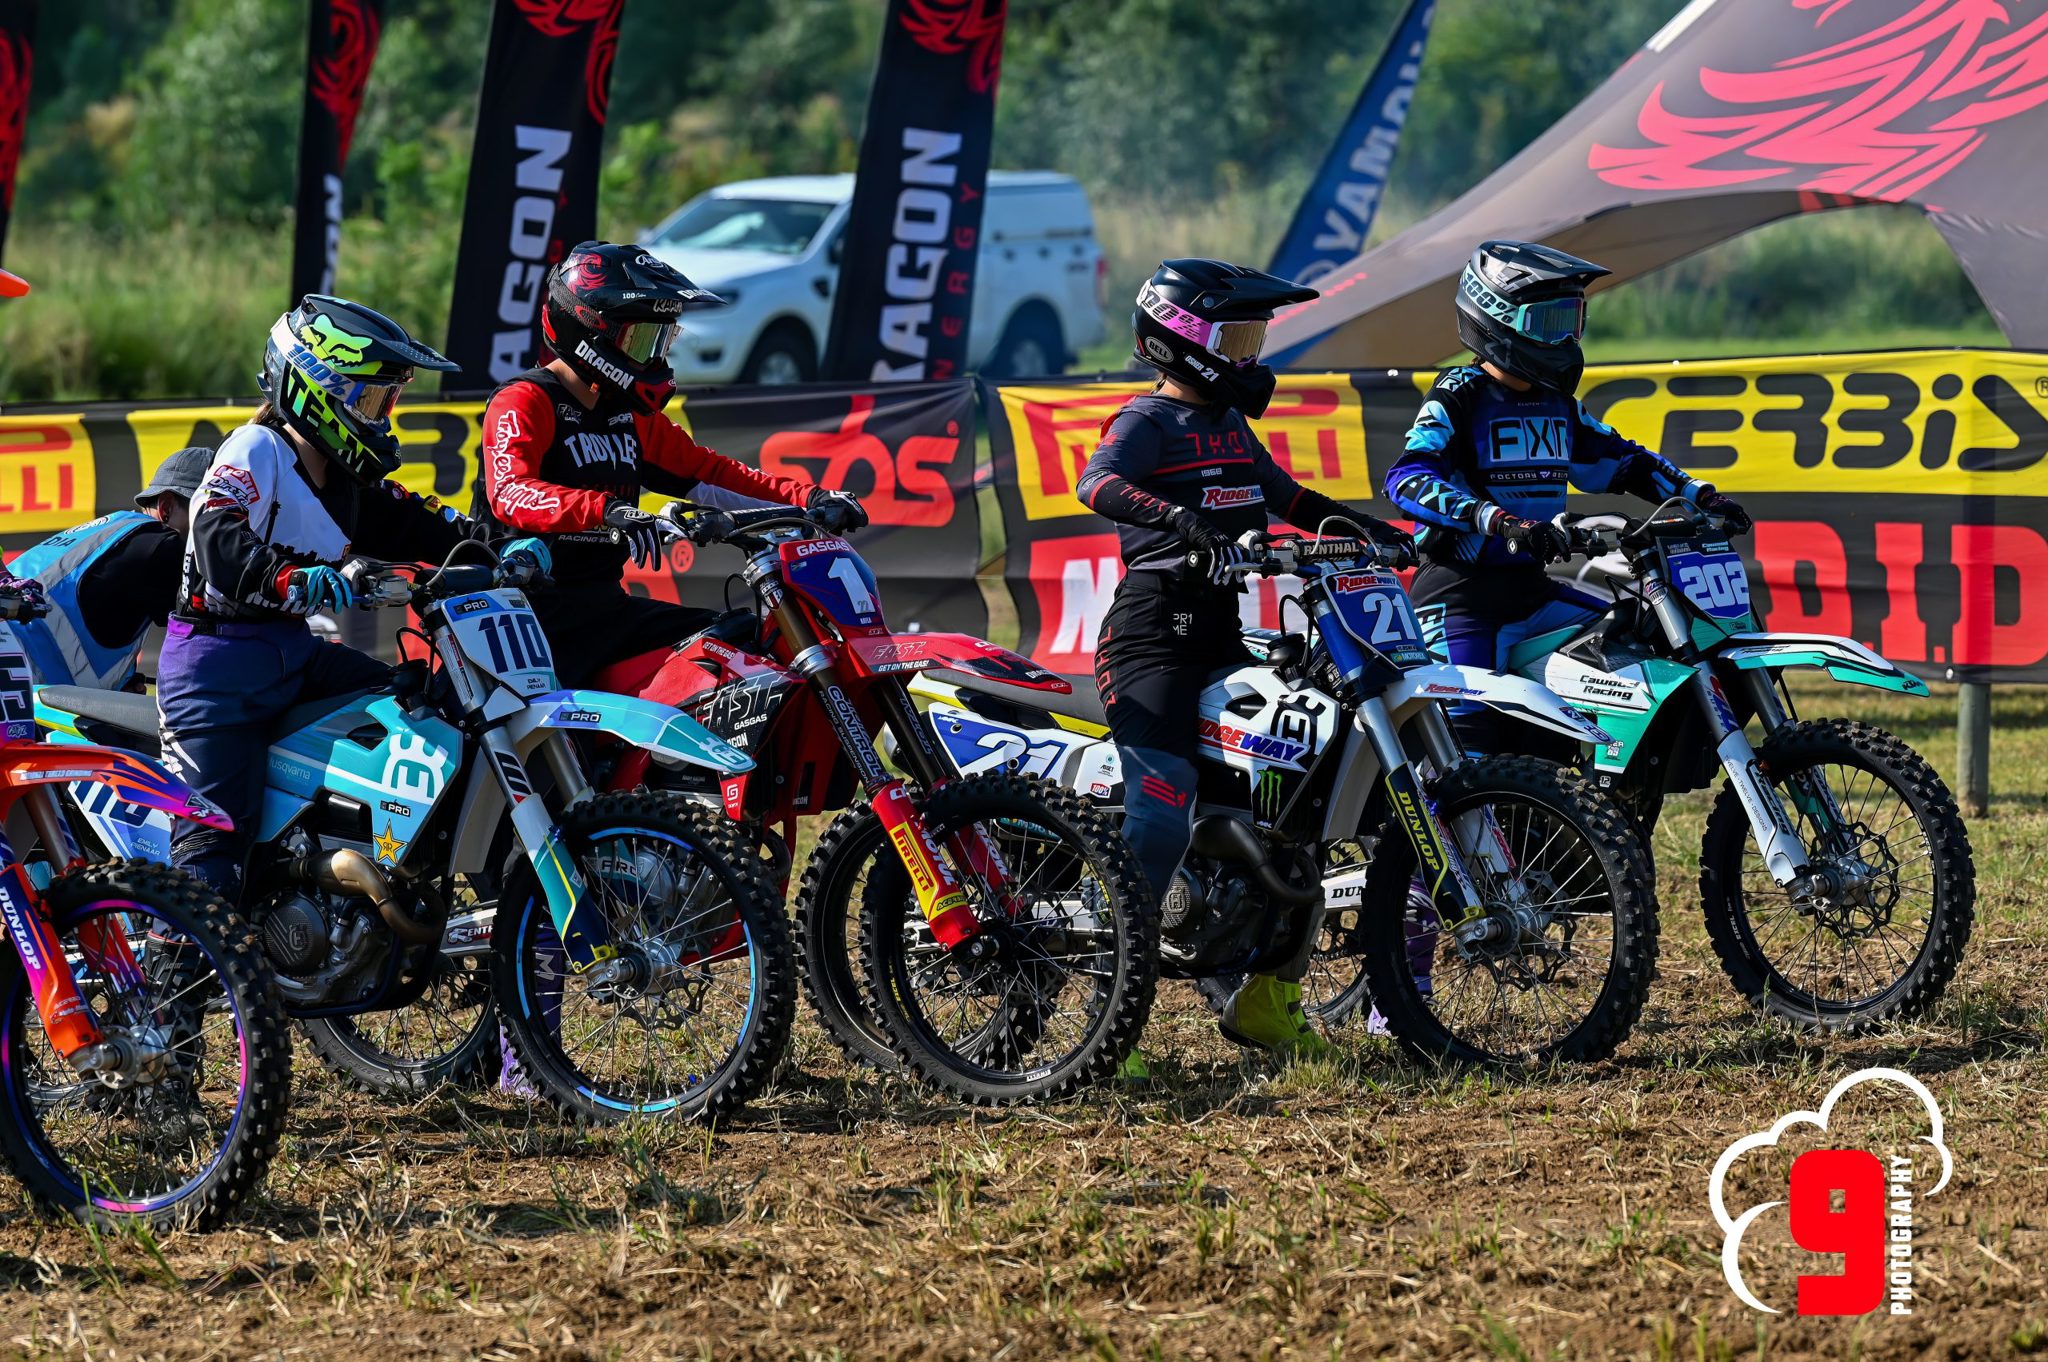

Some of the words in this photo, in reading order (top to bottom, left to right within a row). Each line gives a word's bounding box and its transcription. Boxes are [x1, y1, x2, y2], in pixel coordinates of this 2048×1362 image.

[574, 340, 635, 390] DRAGON
[1149, 341, 1169, 359] BELL
[287, 344, 350, 397] 100%
[1201, 367, 1220, 382] 21
[564, 432, 616, 471] TROY
[760, 395, 960, 527] sbs
[797, 541, 850, 556] GASGAS
[1304, 543, 1359, 556] RENTHAL
[828, 557, 875, 614] 1
[1679, 561, 1750, 611] 202
[464, 600, 488, 612] PRO
[1363, 593, 1417, 645] 21
[478, 614, 551, 675] 110
[878, 664, 892, 672] GET
[901, 662, 913, 670] THE
[913, 660, 930, 669] GAS!
[1583, 685, 1634, 701] Racing
[571, 712, 601, 722] PRO
[734, 714, 767, 730] GASGAS
[827, 685, 880, 777] CONTROL
[388, 803, 410, 816] PRO
[1752, 805, 1768, 832] DESIGNS
[1398, 791, 1440, 871] DUNLOP
[894, 827, 934, 892] PIRELLI
[0, 886, 42, 970] DUNLOP
